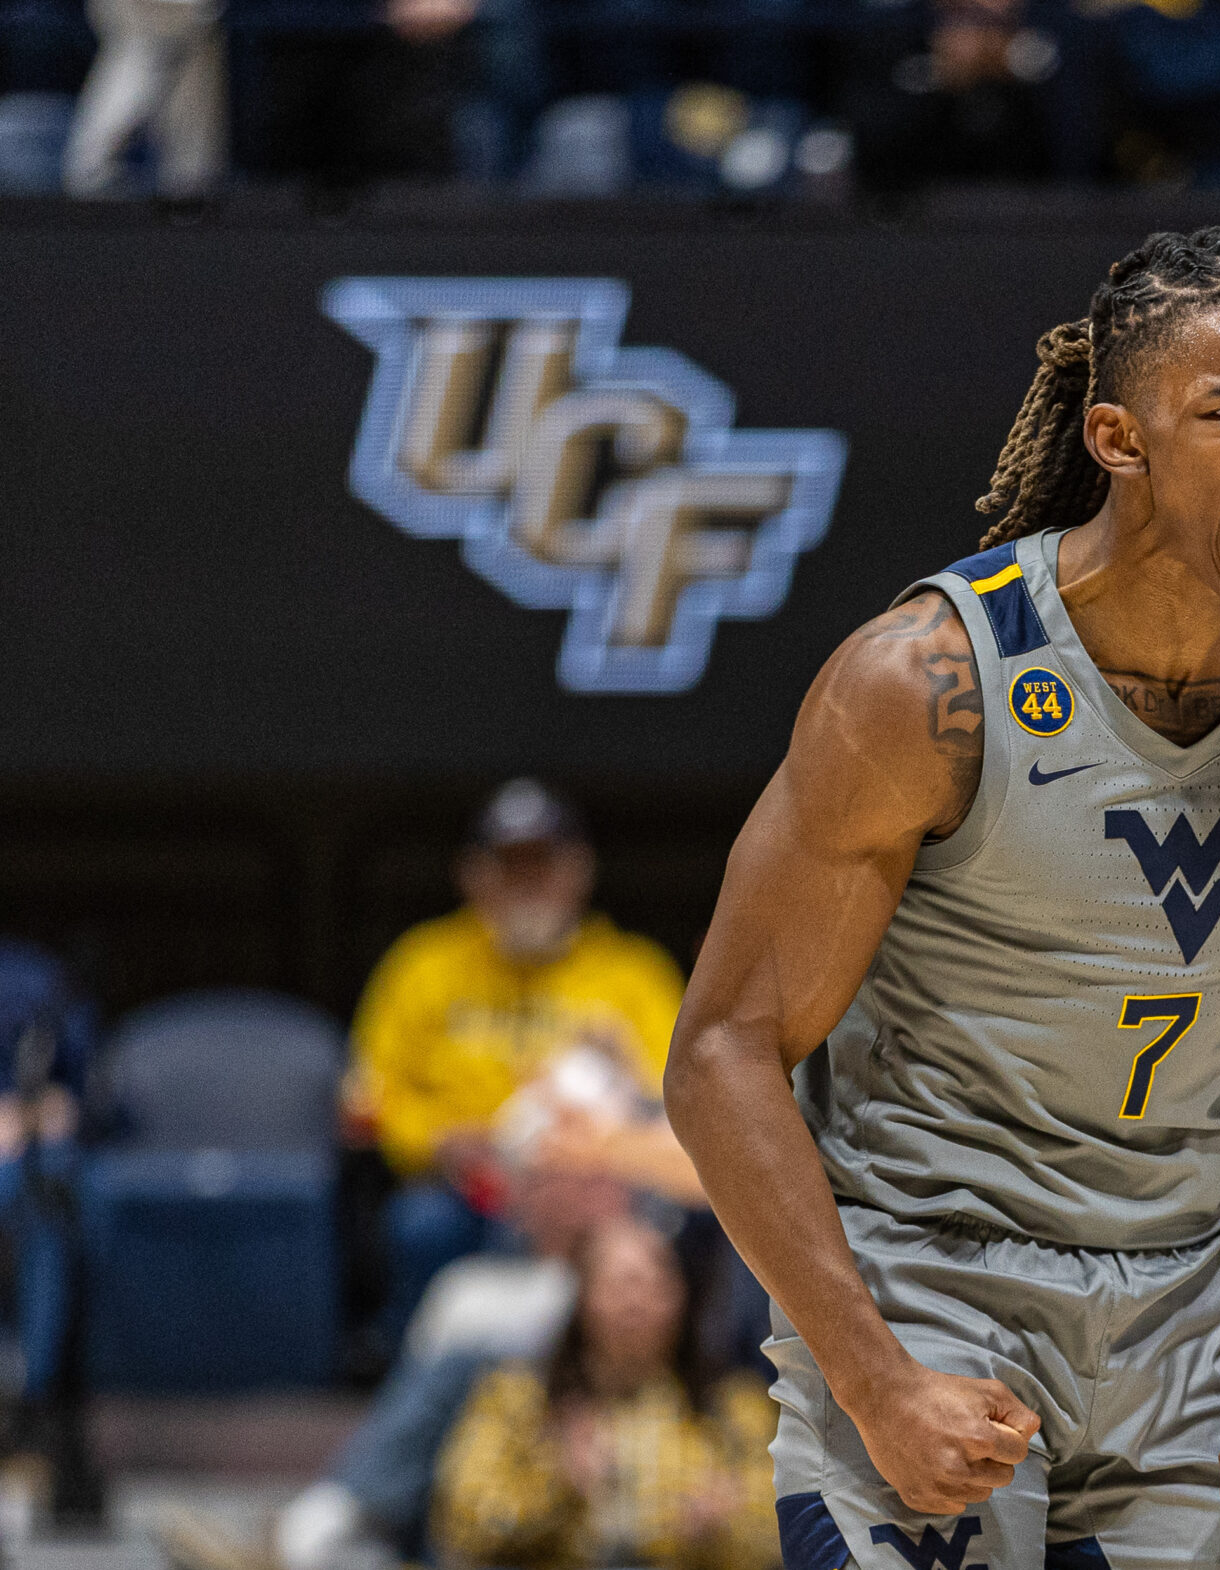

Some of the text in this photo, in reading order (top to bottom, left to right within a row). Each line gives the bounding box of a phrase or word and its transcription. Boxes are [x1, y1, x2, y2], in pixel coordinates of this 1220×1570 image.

[340, 284, 832, 680] UCF
[1021, 692, 1063, 720] 44
[1023, 681, 1057, 693] WEST
[1117, 992, 1203, 1120] 7
